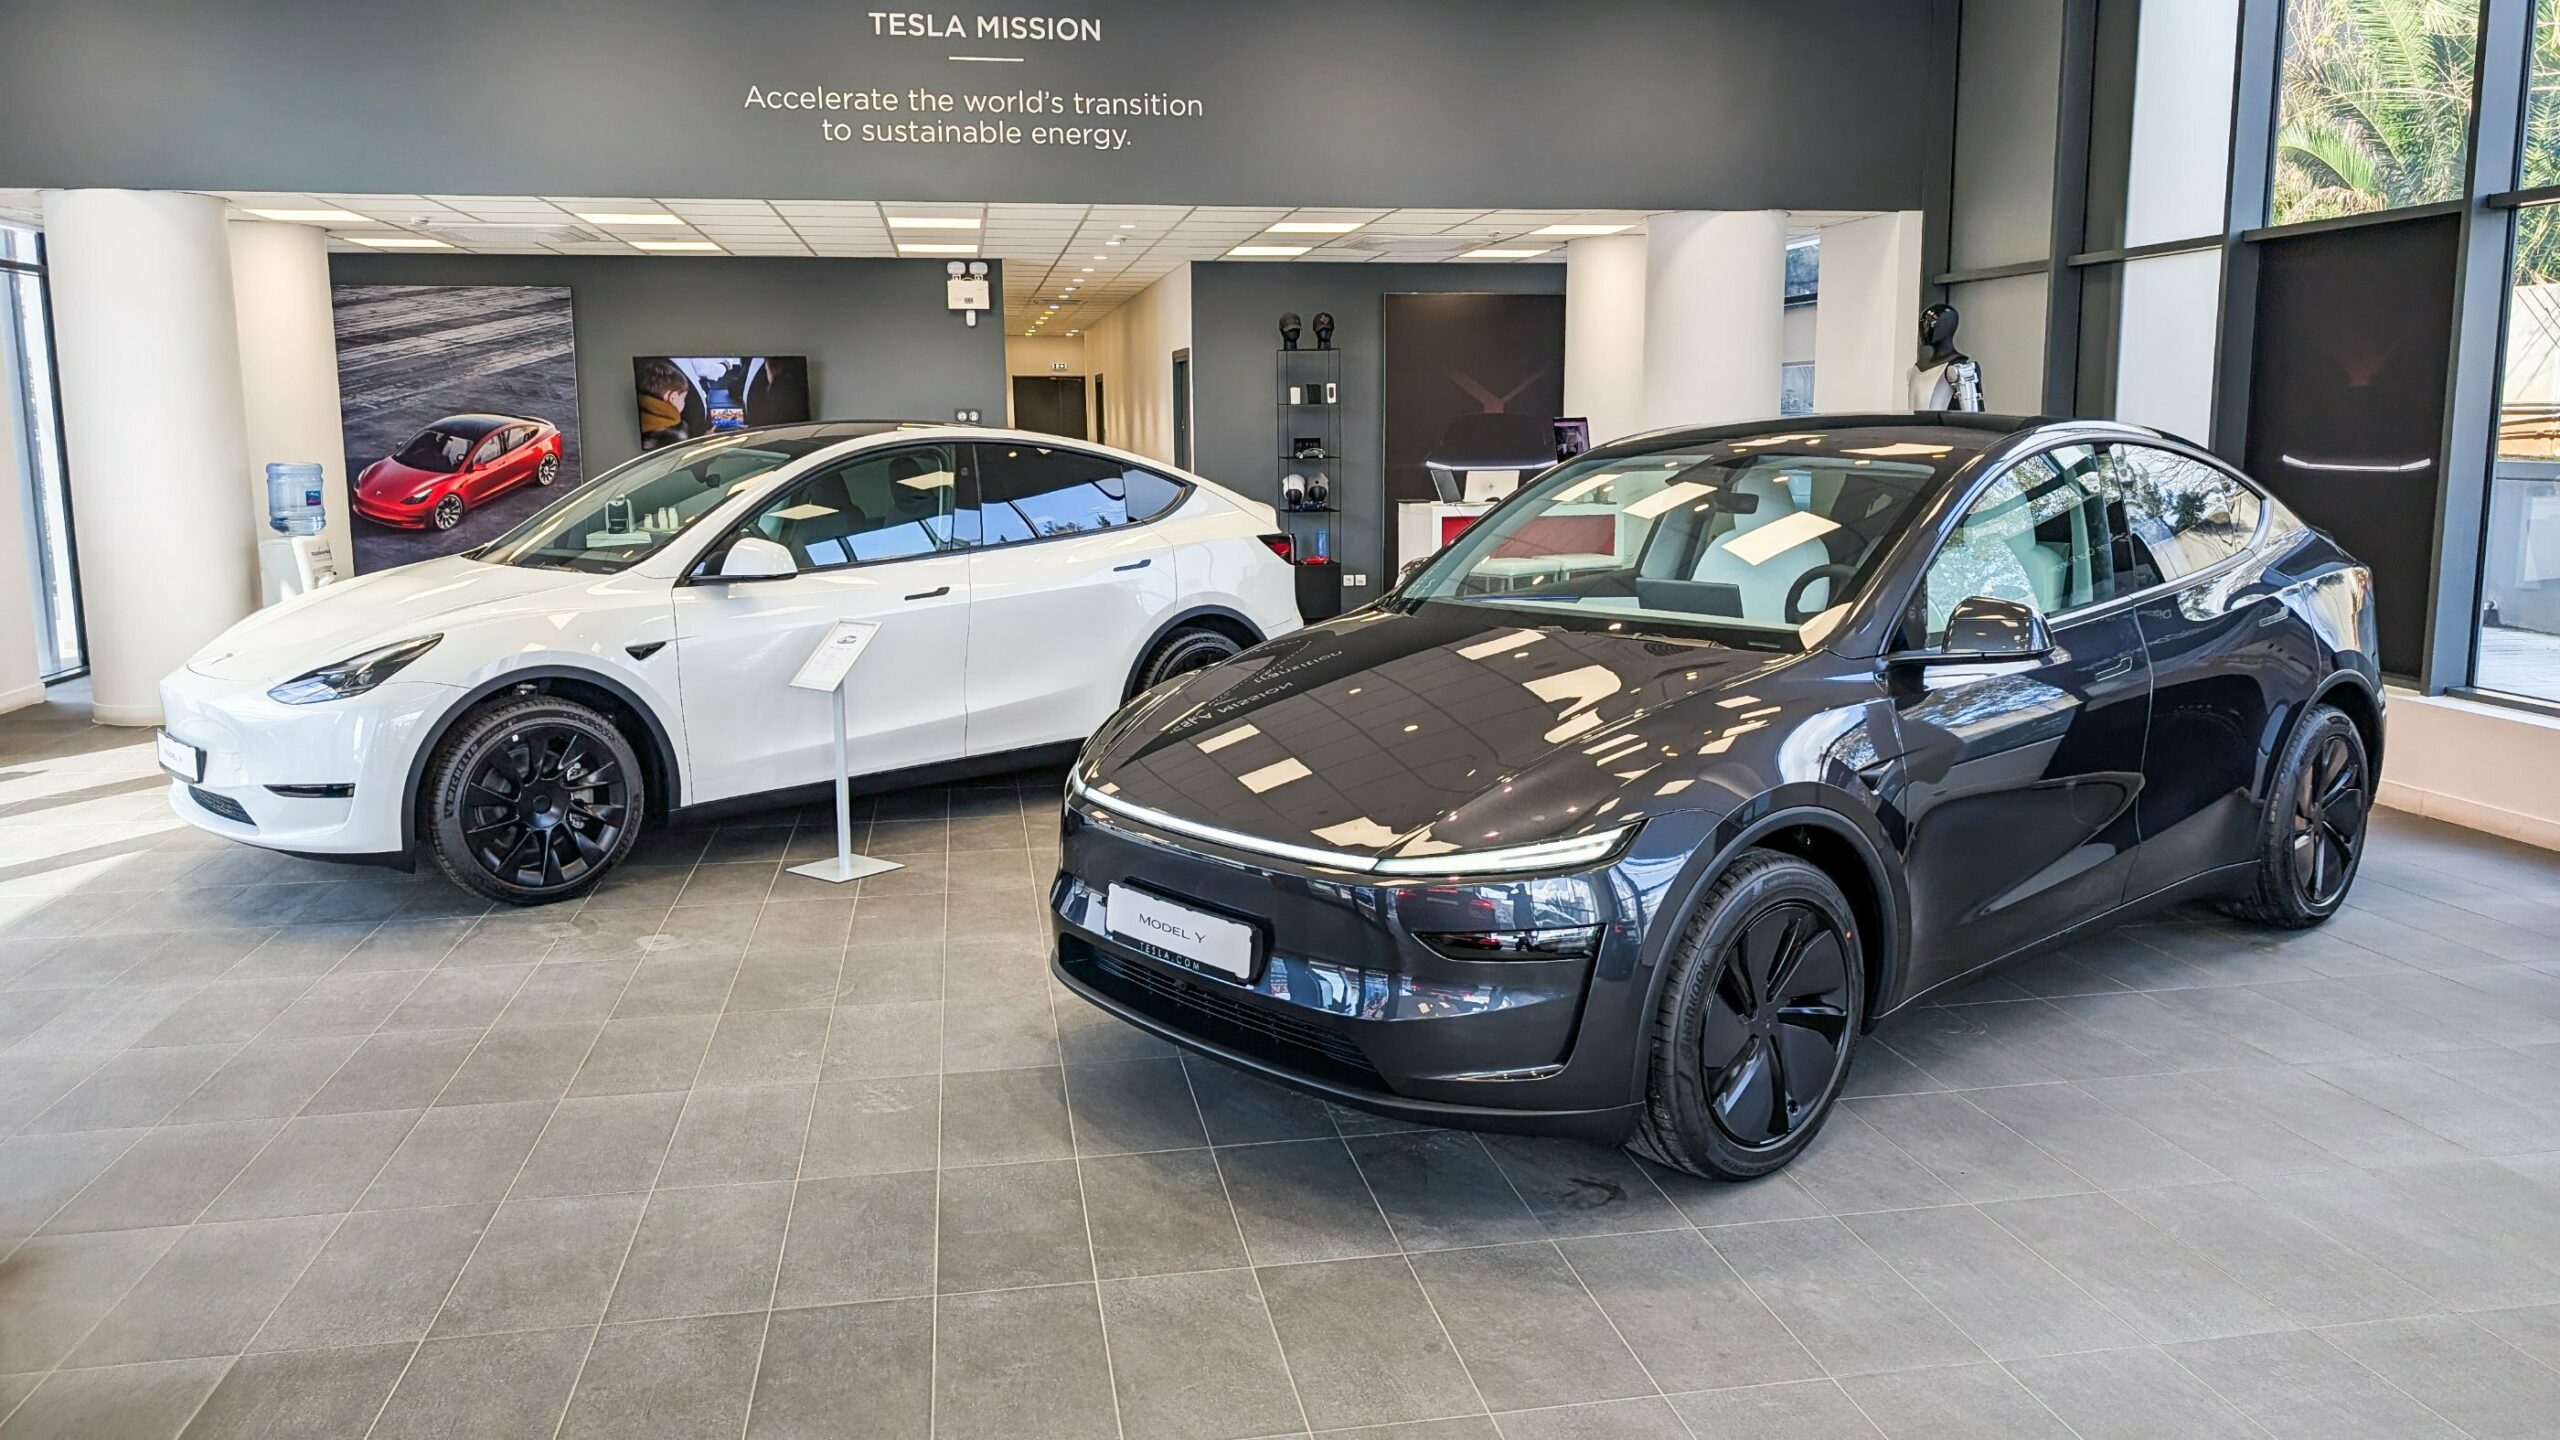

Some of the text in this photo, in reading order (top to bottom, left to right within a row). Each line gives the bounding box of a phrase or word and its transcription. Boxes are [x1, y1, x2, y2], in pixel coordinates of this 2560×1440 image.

[868, 12, 1101, 41] TESLA MISSION
[744, 85, 1203, 117] Accelerate the world’s transition
[821, 118, 1131, 150] to sustainable energy.
[446, 743, 479, 803] MICHELIN
[1138, 913, 1207, 944] MODEL Y
[1139, 942, 1200, 971] TESLA.COM
